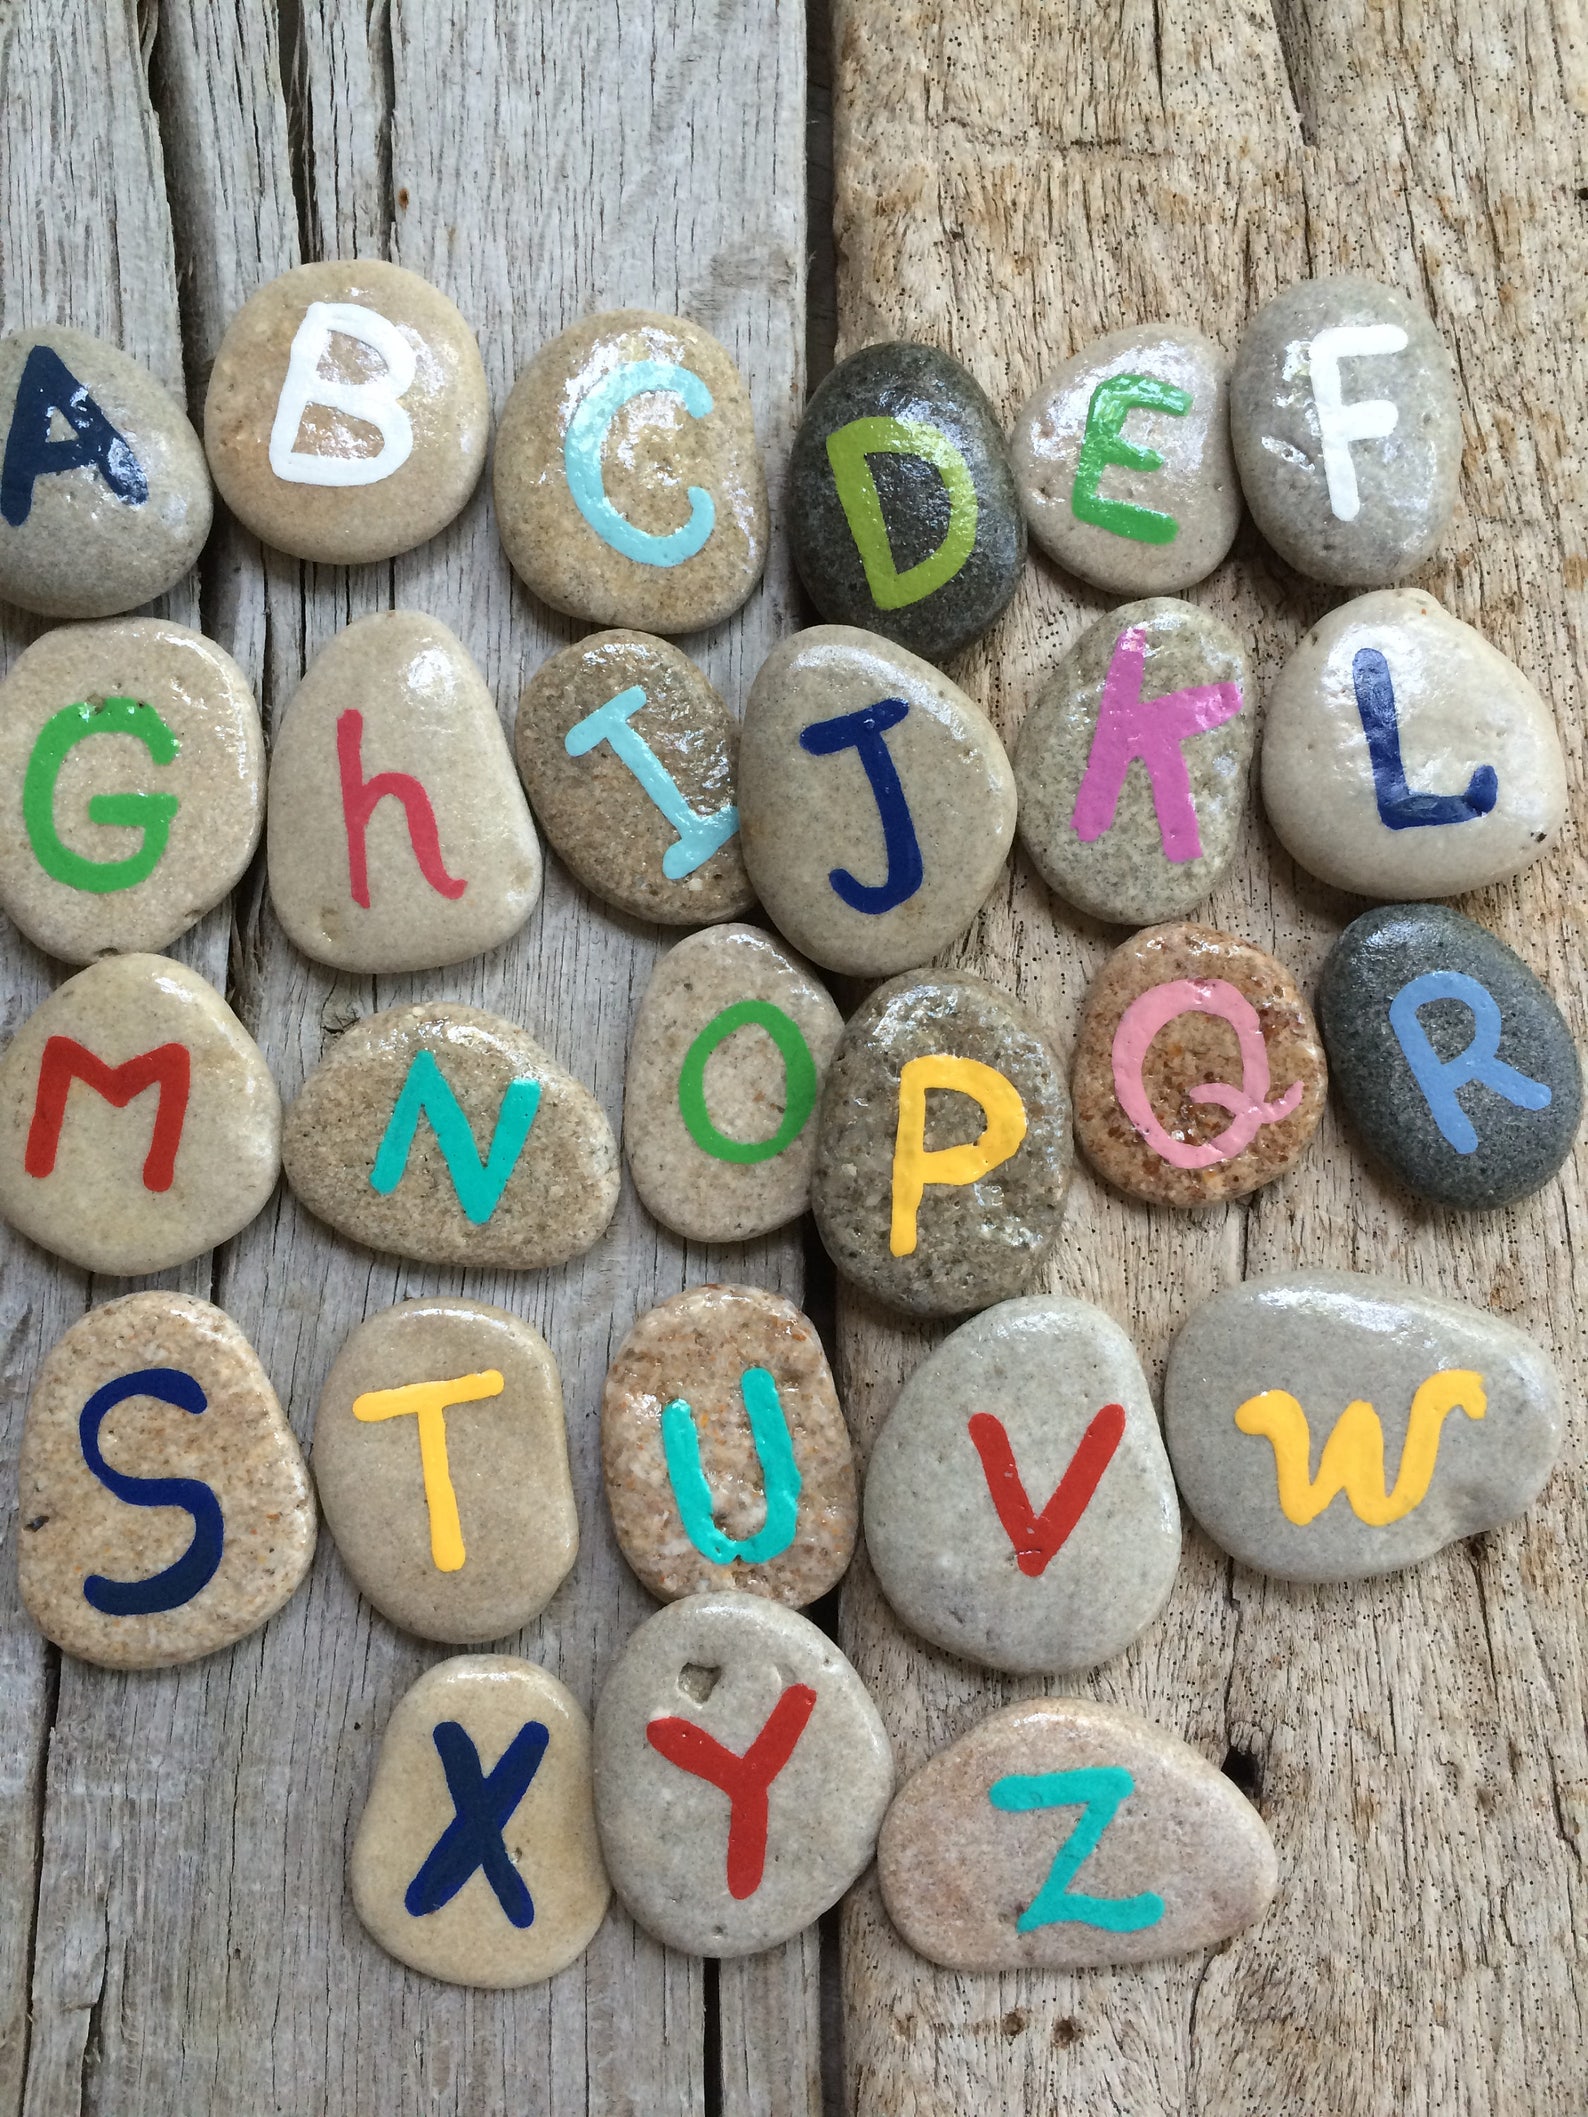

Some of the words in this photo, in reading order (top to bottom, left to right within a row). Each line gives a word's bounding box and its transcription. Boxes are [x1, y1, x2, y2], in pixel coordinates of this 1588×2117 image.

[0, 342, 149, 527] A
[269, 300, 419, 487] B
[563, 358, 716, 567] C
[1074, 373, 1192, 544] E
[1304, 323, 1408, 523] F
[824, 413, 978, 613] D
[24, 697, 177, 894] G
[336, 709, 466, 909] h
[564, 683, 739, 882] I
[800, 698, 924, 914] J
[1072, 627, 1244, 862] K
[1353, 648, 1499, 829] L
[25, 1036, 189, 1192] M
[369, 1048, 541, 1226] N
[678, 999, 818, 1164] O
[889, 1055, 1028, 1259] P
[1111, 979, 1306, 1171] Q
[1387, 973, 1554, 1157] R
[79, 1368, 223, 1615] S
[351, 1369, 505, 1574] T
[662, 1367, 799, 1566] U
[968, 1403, 1123, 1576] V
[405, 1719, 550, 1928] X
[647, 1683, 818, 1900] Y
[990, 1765, 1165, 1934] Z
